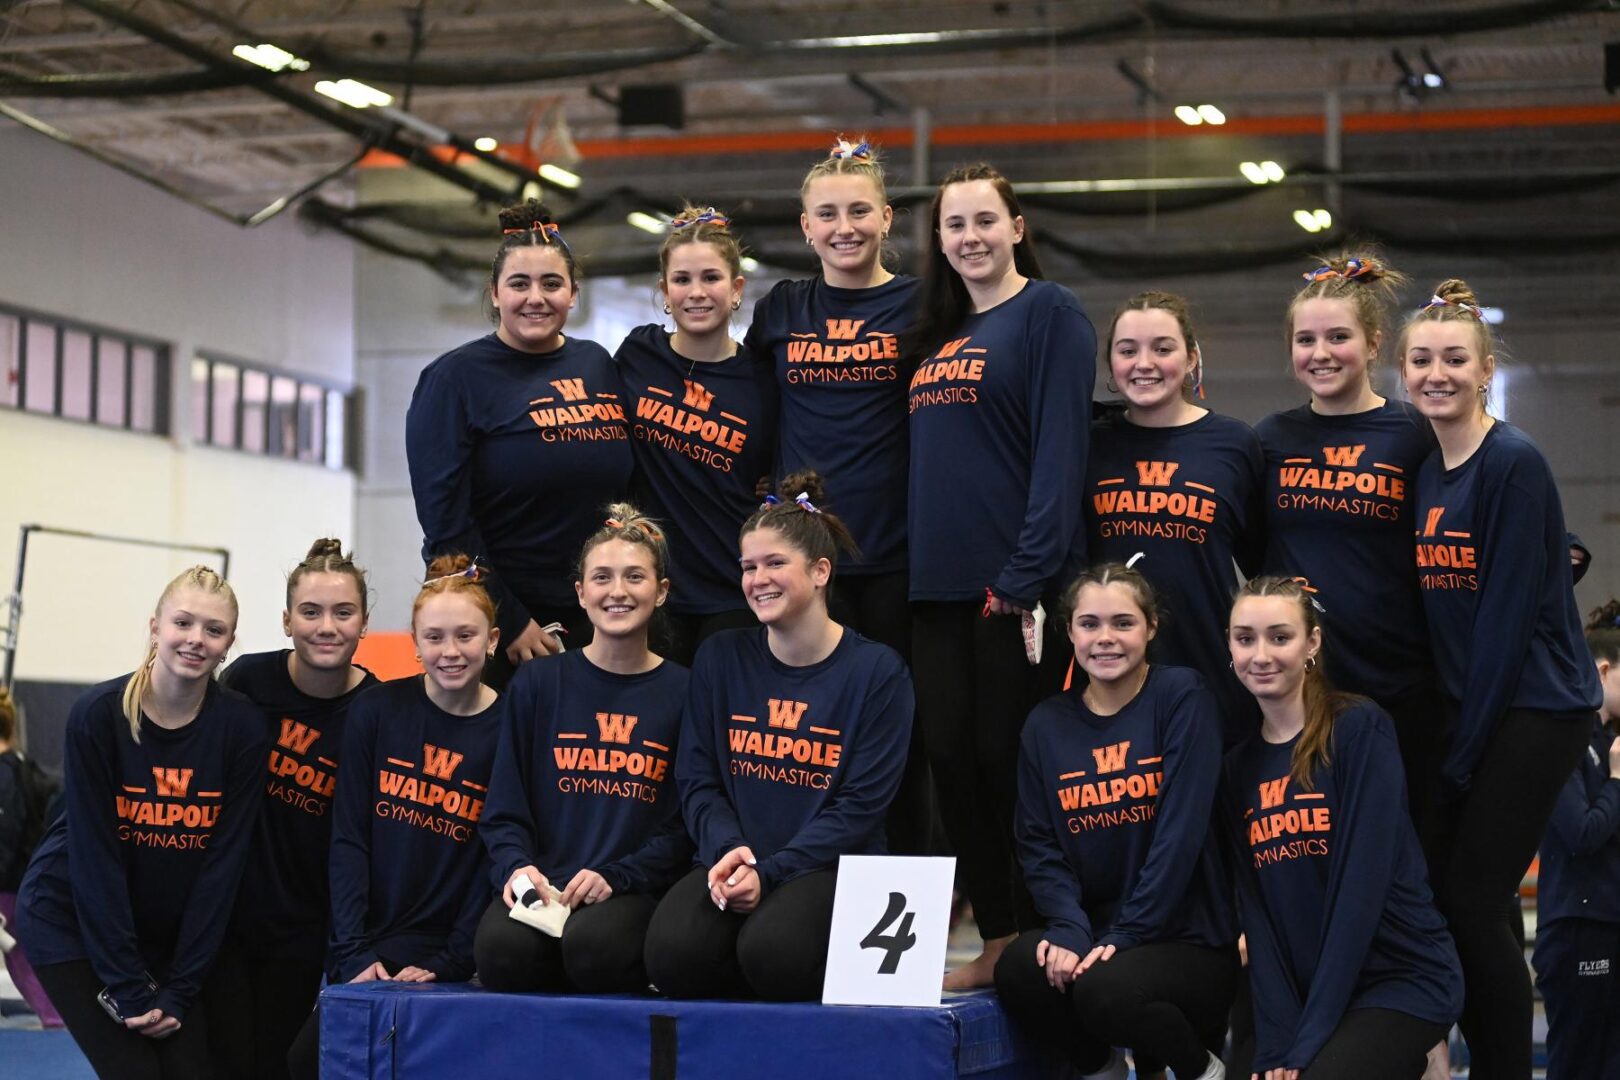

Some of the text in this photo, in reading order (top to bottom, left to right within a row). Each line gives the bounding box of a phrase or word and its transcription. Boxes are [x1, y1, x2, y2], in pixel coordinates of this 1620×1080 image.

[826, 319, 864, 340] W
[787, 337, 898, 362] WALPOLE
[549, 378, 588, 401] W
[787, 365, 897, 384] GYMNASTICS
[909, 359, 985, 391] ALPOLE
[682, 379, 715, 412] W
[636, 397, 746, 454] WALPOLE
[634, 424, 733, 472] GYMNASTICS
[1323, 444, 1366, 467] W
[1135, 461, 1179, 486] W
[1280, 467, 1405, 500] WALPOLE
[1093, 490, 1217, 523] WALPOLE
[1277, 493, 1399, 520] GYMNASTICS
[1101, 520, 1206, 544] GYMNASTICS
[596, 712, 638, 744] W
[768, 698, 808, 730] W
[277, 718, 321, 756] W
[729, 729, 842, 768] WALPOLE
[423, 743, 464, 780] W
[553, 747, 668, 782] WALPOLE
[1092, 740, 1130, 775] W
[152, 766, 193, 797] W
[558, 777, 657, 803] GYMNASTICS
[730, 759, 832, 790] GYMNASTICS
[380, 770, 485, 822] WALPOLE
[1259, 775, 1291, 810] W
[116, 796, 221, 828] WALPOL
[1249, 808, 1331, 846] ALPOLE
[860, 892, 916, 974] 4
